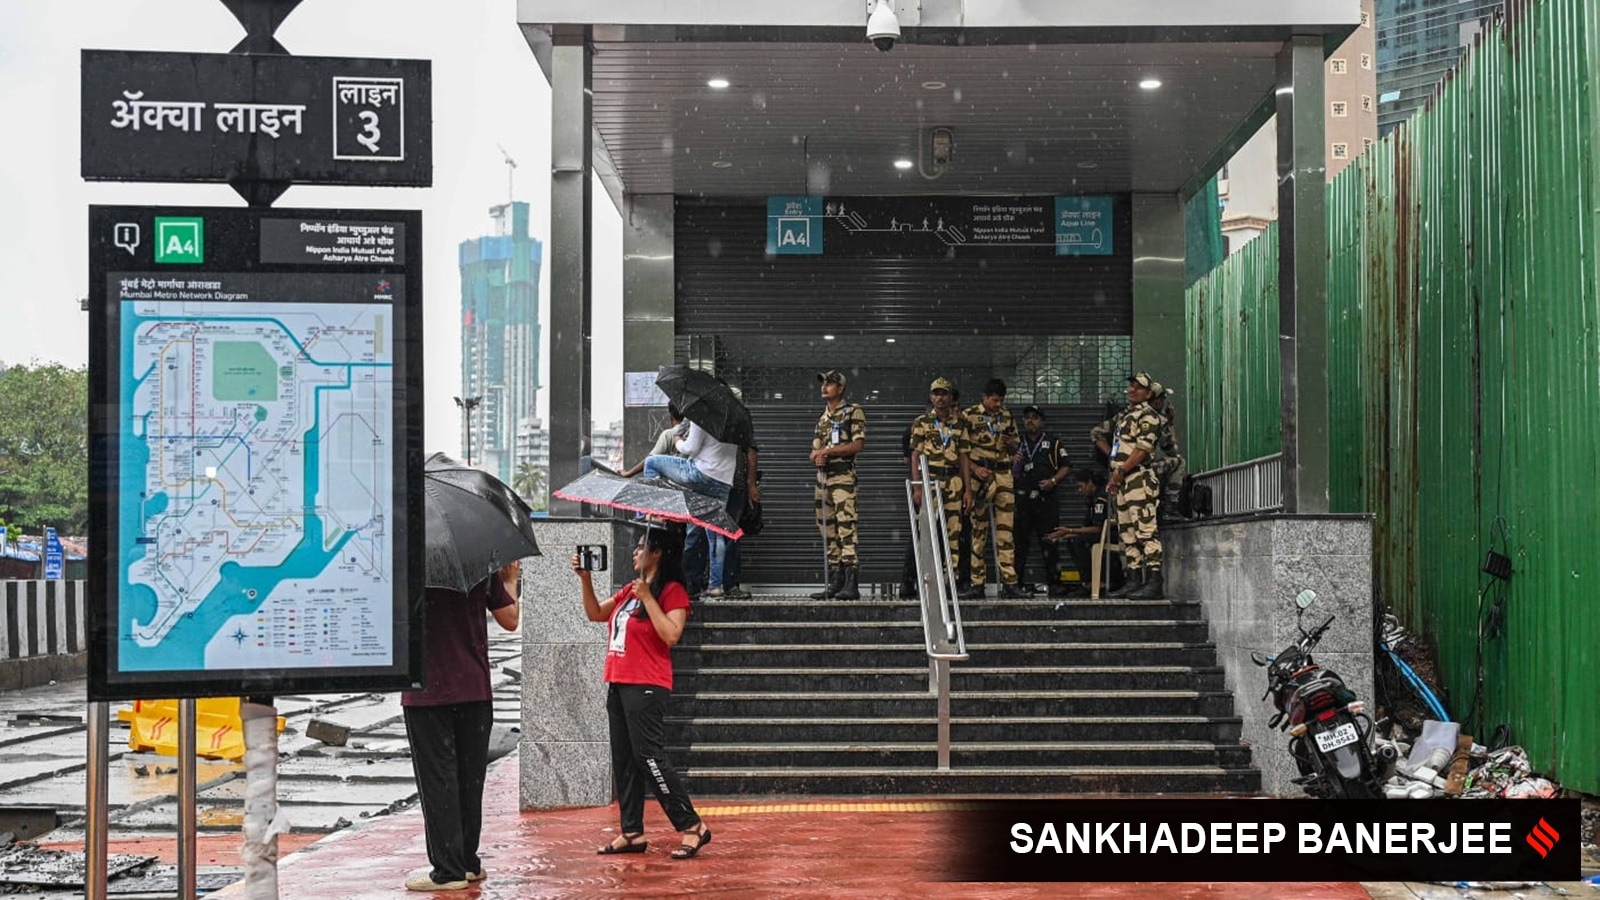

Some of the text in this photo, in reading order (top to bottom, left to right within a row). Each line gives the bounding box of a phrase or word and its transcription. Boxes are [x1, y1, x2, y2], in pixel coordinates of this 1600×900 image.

[338, 84, 398, 106] लाइन
[214, 103, 306, 138] लाइन
[356, 111, 380, 153] ३
[785, 209, 803, 217] Entry
[165, 235, 194, 254] A4
[782, 229, 805, 245] A4
[306, 246, 331, 254] Nippon
[333, 246, 350, 254] India
[377, 247, 394, 255] Fund
[323, 254, 352, 263] Acharya
[120, 291, 248, 301] Mumbai Metro Network Diagram
